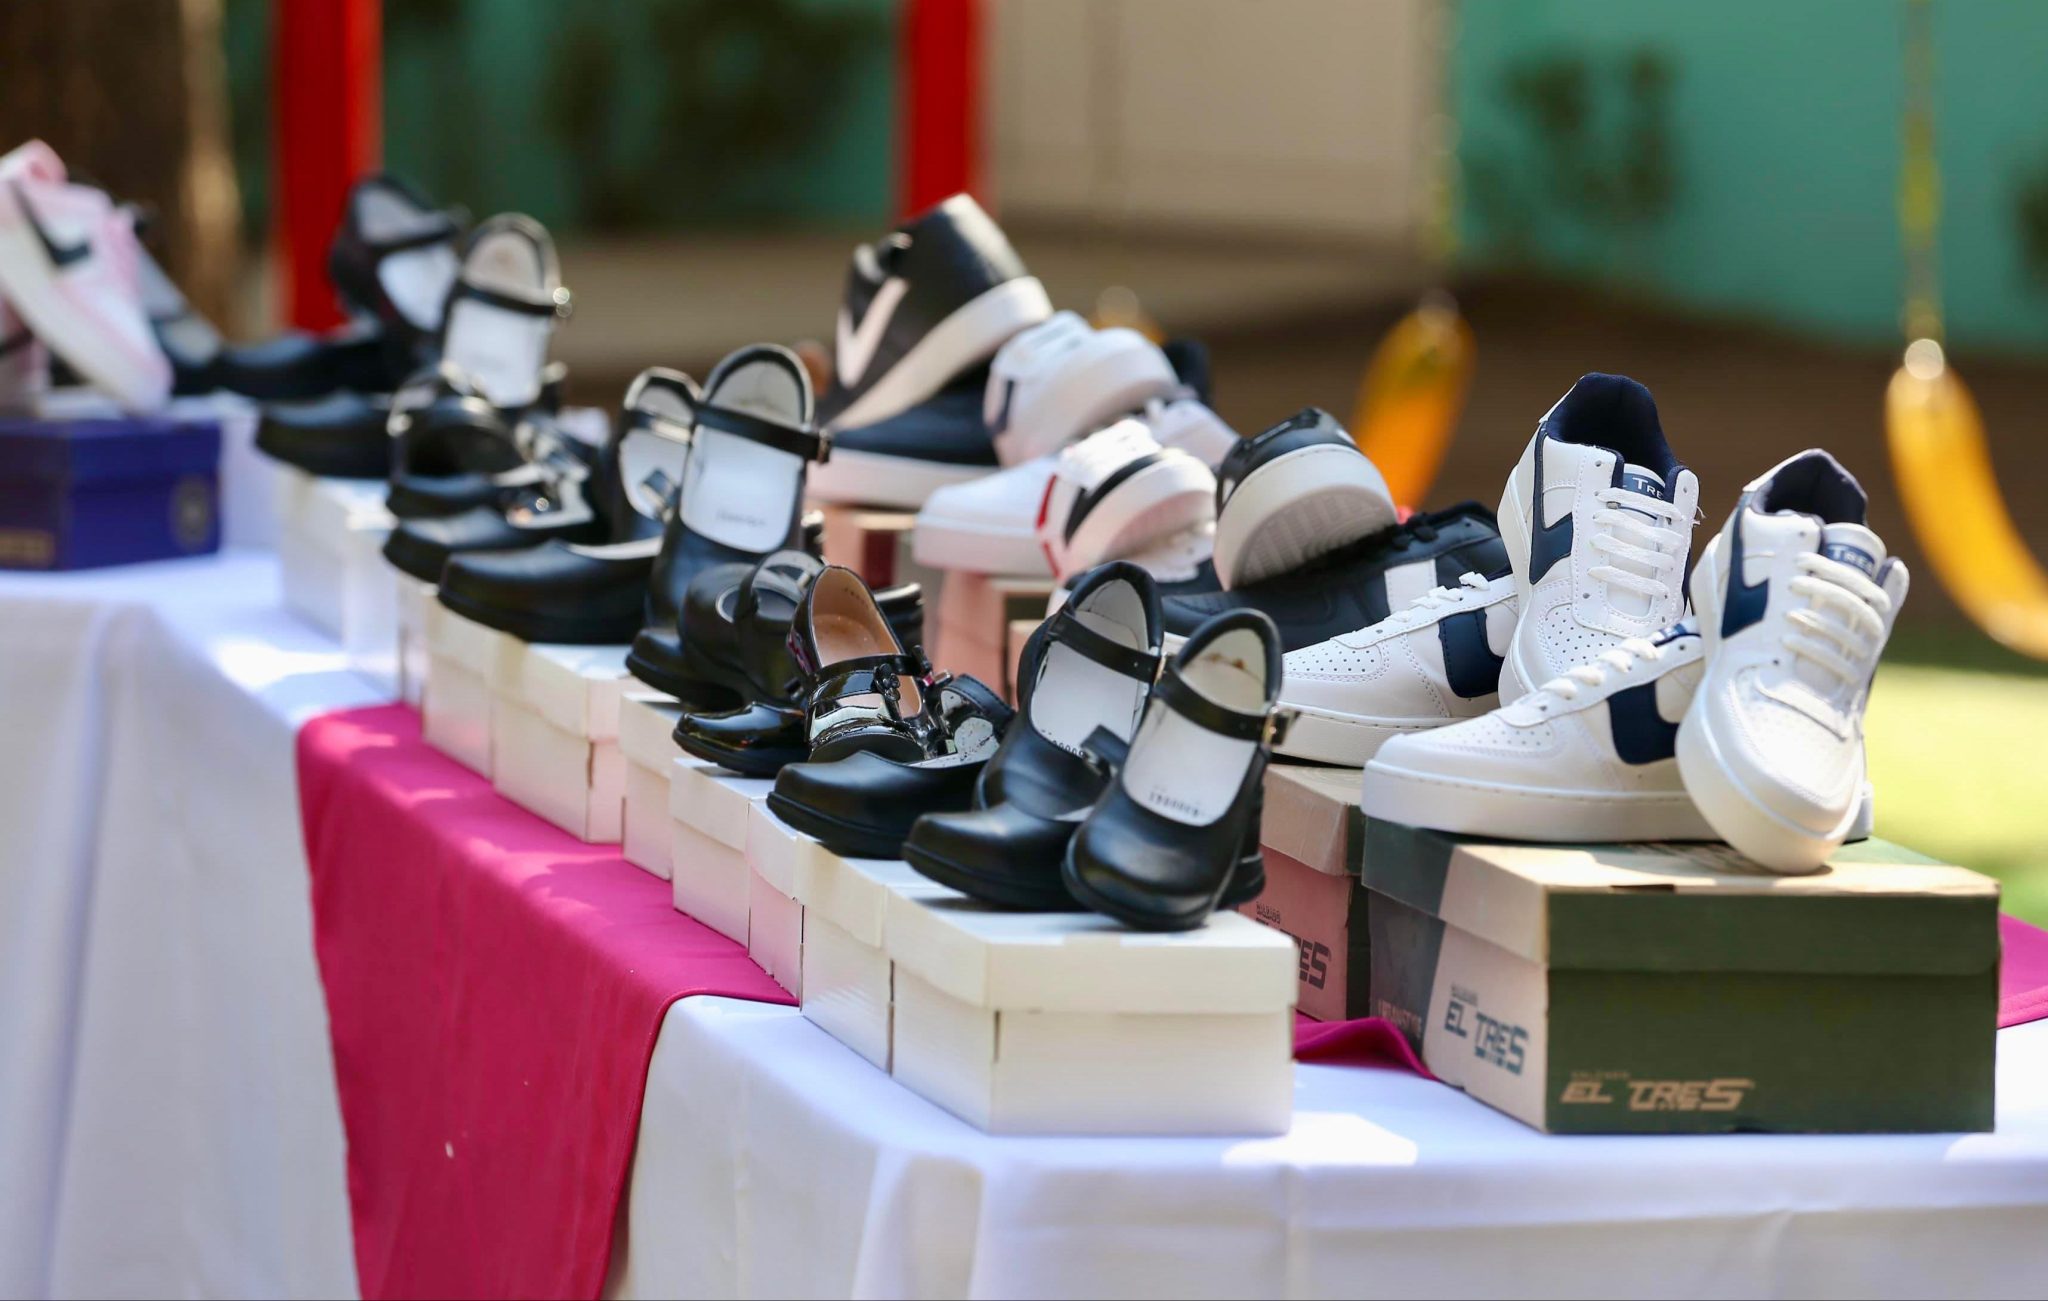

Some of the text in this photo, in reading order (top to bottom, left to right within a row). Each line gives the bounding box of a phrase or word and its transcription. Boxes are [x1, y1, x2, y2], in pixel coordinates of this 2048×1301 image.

[1632, 477, 1664, 500] TRE
[1444, 1000, 1468, 1038] EL
[1475, 1012, 1529, 1076] TRES
[1560, 1078, 1755, 1112] EL TRES
